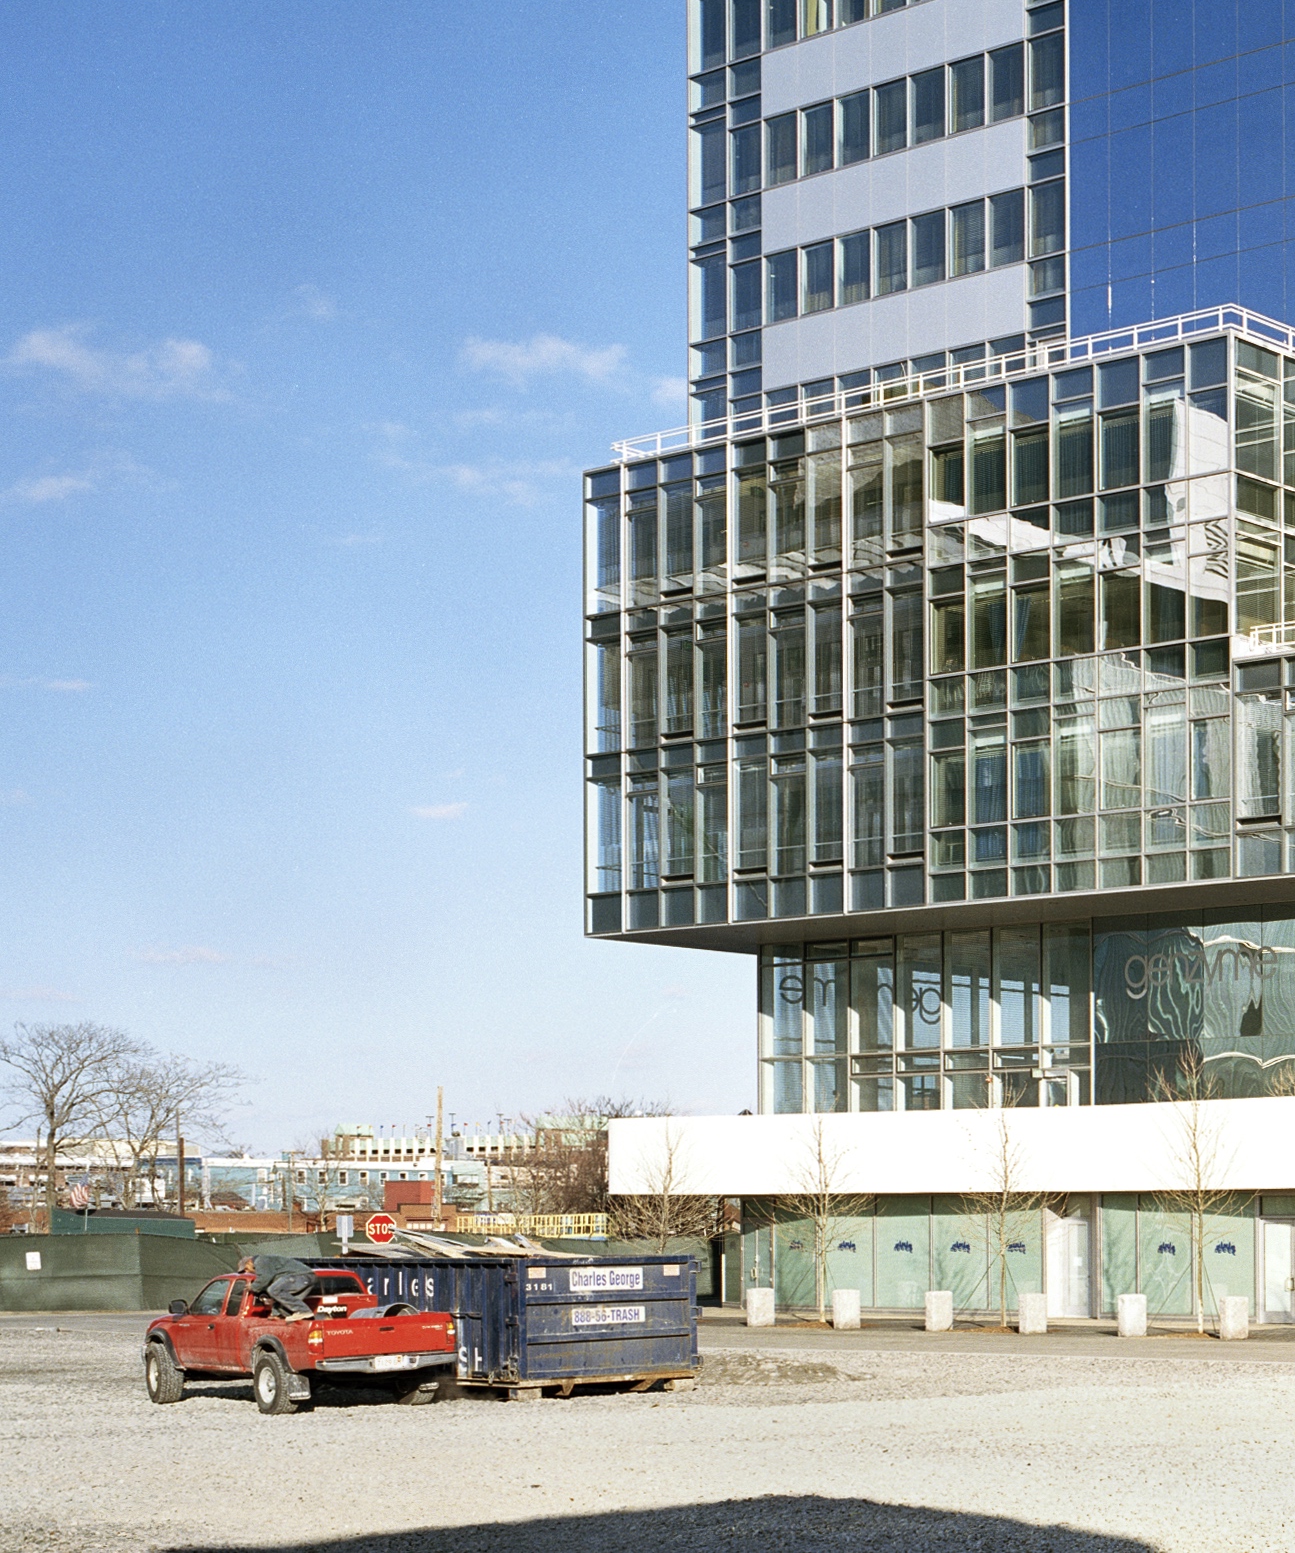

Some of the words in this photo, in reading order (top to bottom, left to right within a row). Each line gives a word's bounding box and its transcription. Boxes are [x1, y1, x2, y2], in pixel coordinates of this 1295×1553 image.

[1124, 946, 1278, 1000] genzyme
[572, 1270, 607, 1287] Charles
[609, 1270, 641, 1288] George
[526, 1283, 553, 1291] 3181
[317, 1305, 347, 1313] Dayton
[574, 1308, 640, 1323] 888-56-TRASH
